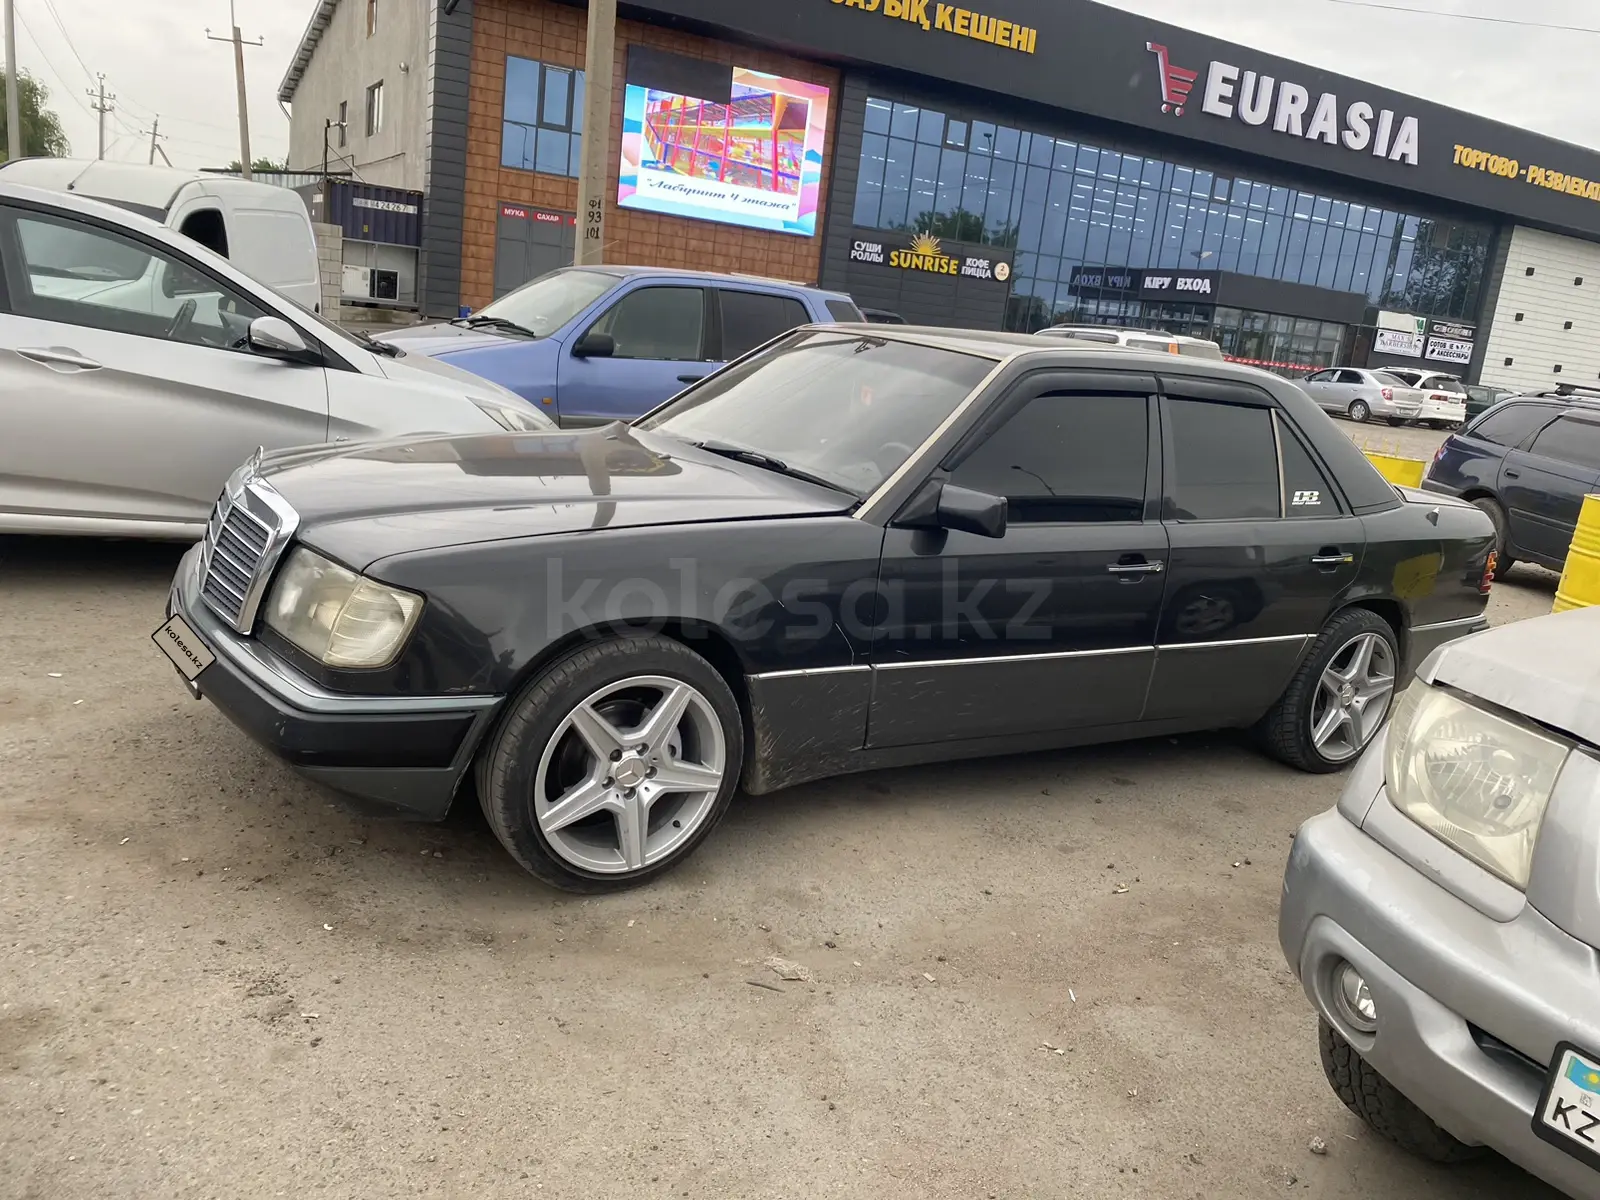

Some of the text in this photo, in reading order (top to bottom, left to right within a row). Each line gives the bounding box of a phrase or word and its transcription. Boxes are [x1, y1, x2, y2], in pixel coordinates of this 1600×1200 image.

[935, 3, 1037, 54] КЕШЕНІ
[1201, 60, 1419, 166] EURASIA
[1453, 144, 1519, 179] ТОРГОВО
[504, 208, 525, 217] МУКА
[536, 213, 560, 222] САХАР
[588, 211, 602, 223] 93
[854, 241, 882, 253] СУШИ
[850, 251, 884, 263] РОЛЛЫ
[889, 251, 960, 275] SUNRISE
[965, 257, 990, 269] КОФЕ
[961, 266, 992, 279] ПИЦЦА
[1144, 276, 1211, 294] КІРУ ВХОД
[1552, 1096, 1600, 1143] KZ
